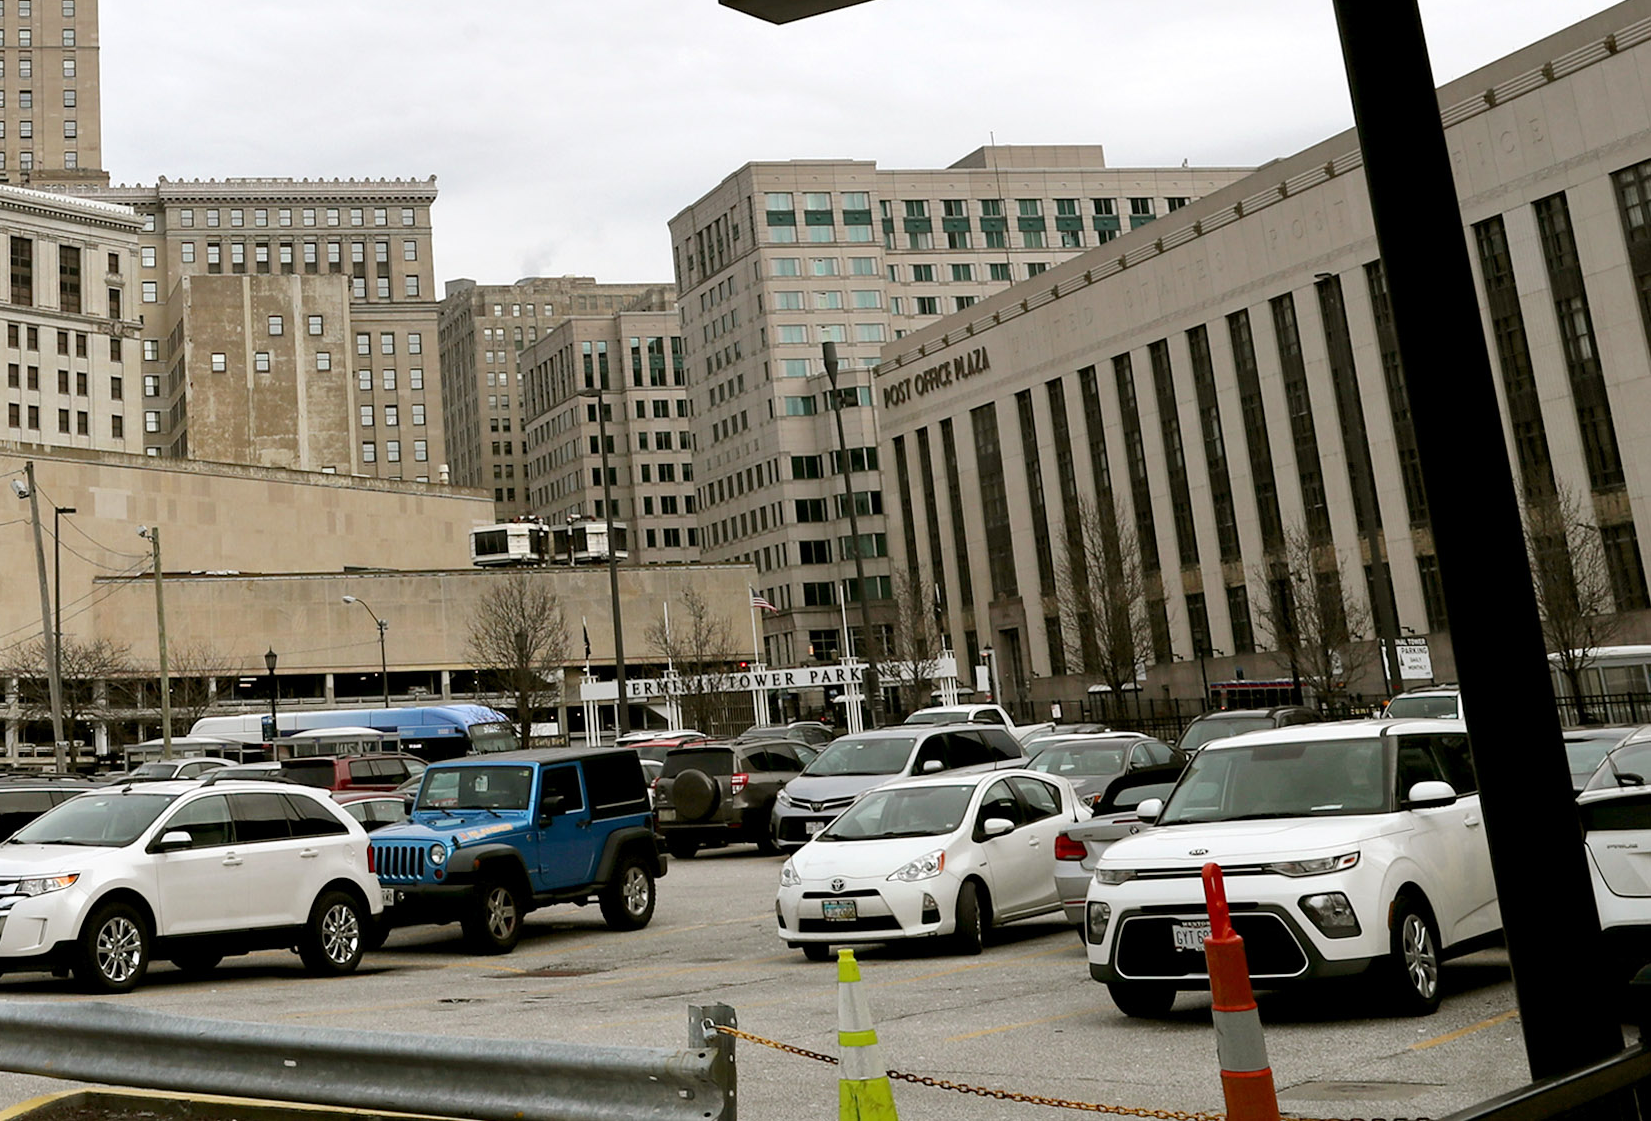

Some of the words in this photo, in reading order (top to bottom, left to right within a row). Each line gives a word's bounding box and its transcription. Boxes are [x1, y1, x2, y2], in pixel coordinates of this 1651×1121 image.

[1269, 199, 1345, 251] POST
[1453, 118, 1545, 173] FICE
[883, 373, 912, 409] POST
[914, 360, 953, 397] OFFICE
[953, 345, 992, 381] PLAZA
[1401, 646, 1428, 655] PARKING
[728, 671, 795, 691] TOWER
[810, 664, 902, 684] PARKNG
[1176, 930, 1195, 945] GYT
